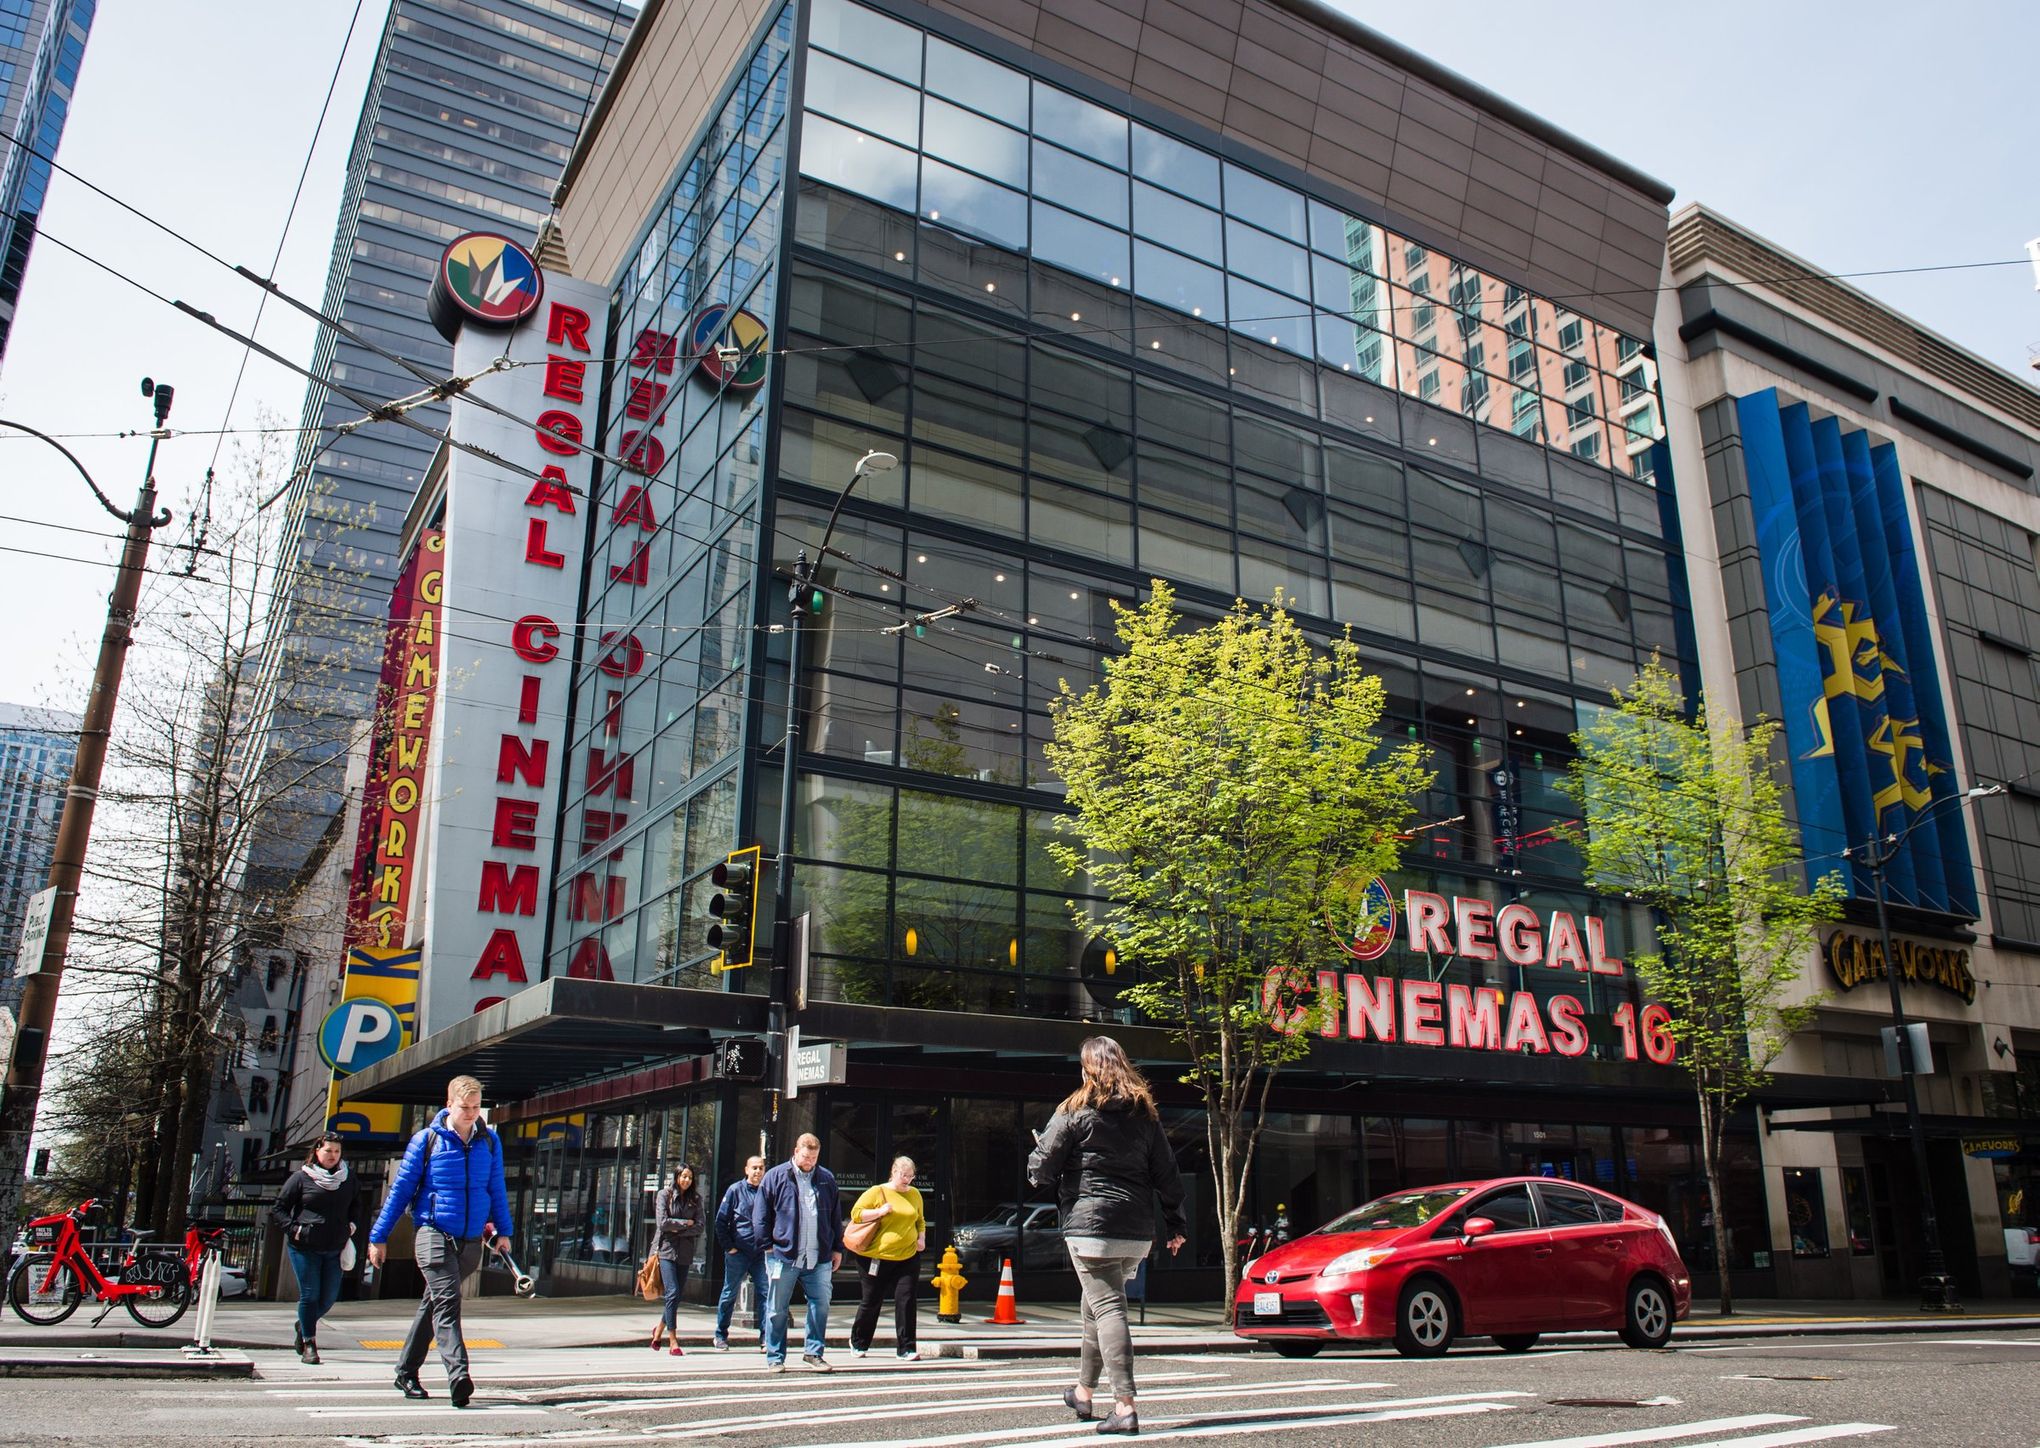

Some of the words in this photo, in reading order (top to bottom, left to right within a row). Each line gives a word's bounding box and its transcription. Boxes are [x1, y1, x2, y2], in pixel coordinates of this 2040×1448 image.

[525, 301, 591, 569] REGAL
[376, 570, 444, 947] GAMEWORKS
[470, 614, 560, 1014] CINEMA
[23, 927, 46, 944] PARKING
[1404, 889, 1624, 977] REGAL
[1829, 930, 1976, 1005] GAMEWORKS
[336, 1004, 392, 1064] P
[1262, 966, 1588, 1057] CINEMAS
[1613, 1002, 1676, 1065] 16
[797, 1050, 821, 1066] REGAL
[1963, 1140, 2021, 1156] GAMEWORKS
